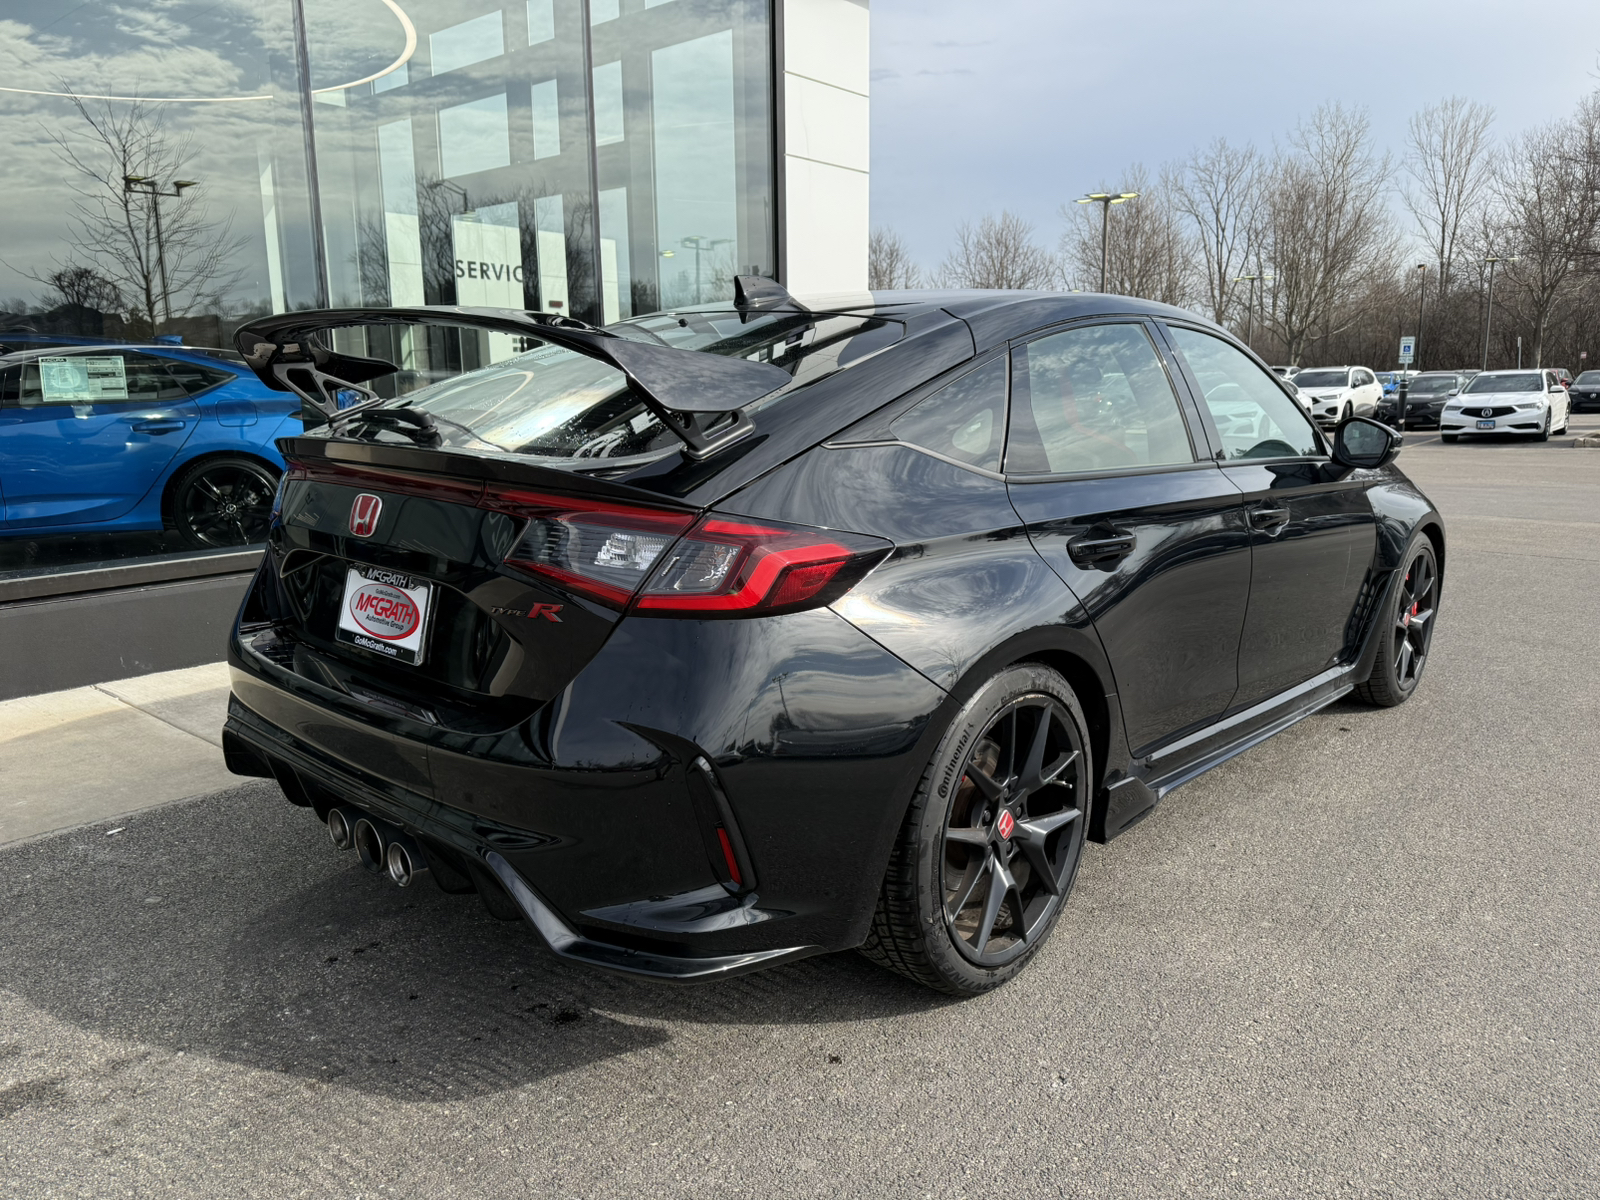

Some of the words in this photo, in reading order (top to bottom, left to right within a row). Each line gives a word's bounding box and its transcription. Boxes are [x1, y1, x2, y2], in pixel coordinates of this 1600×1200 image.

[365, 613, 390, 627] Automotive
[390, 620, 405, 631] Group
[491, 606, 527, 617] TYPE
[527, 601, 564, 622] R
[354, 635, 398, 656] GoMcGrath.com
[937, 728, 972, 799] Continental
